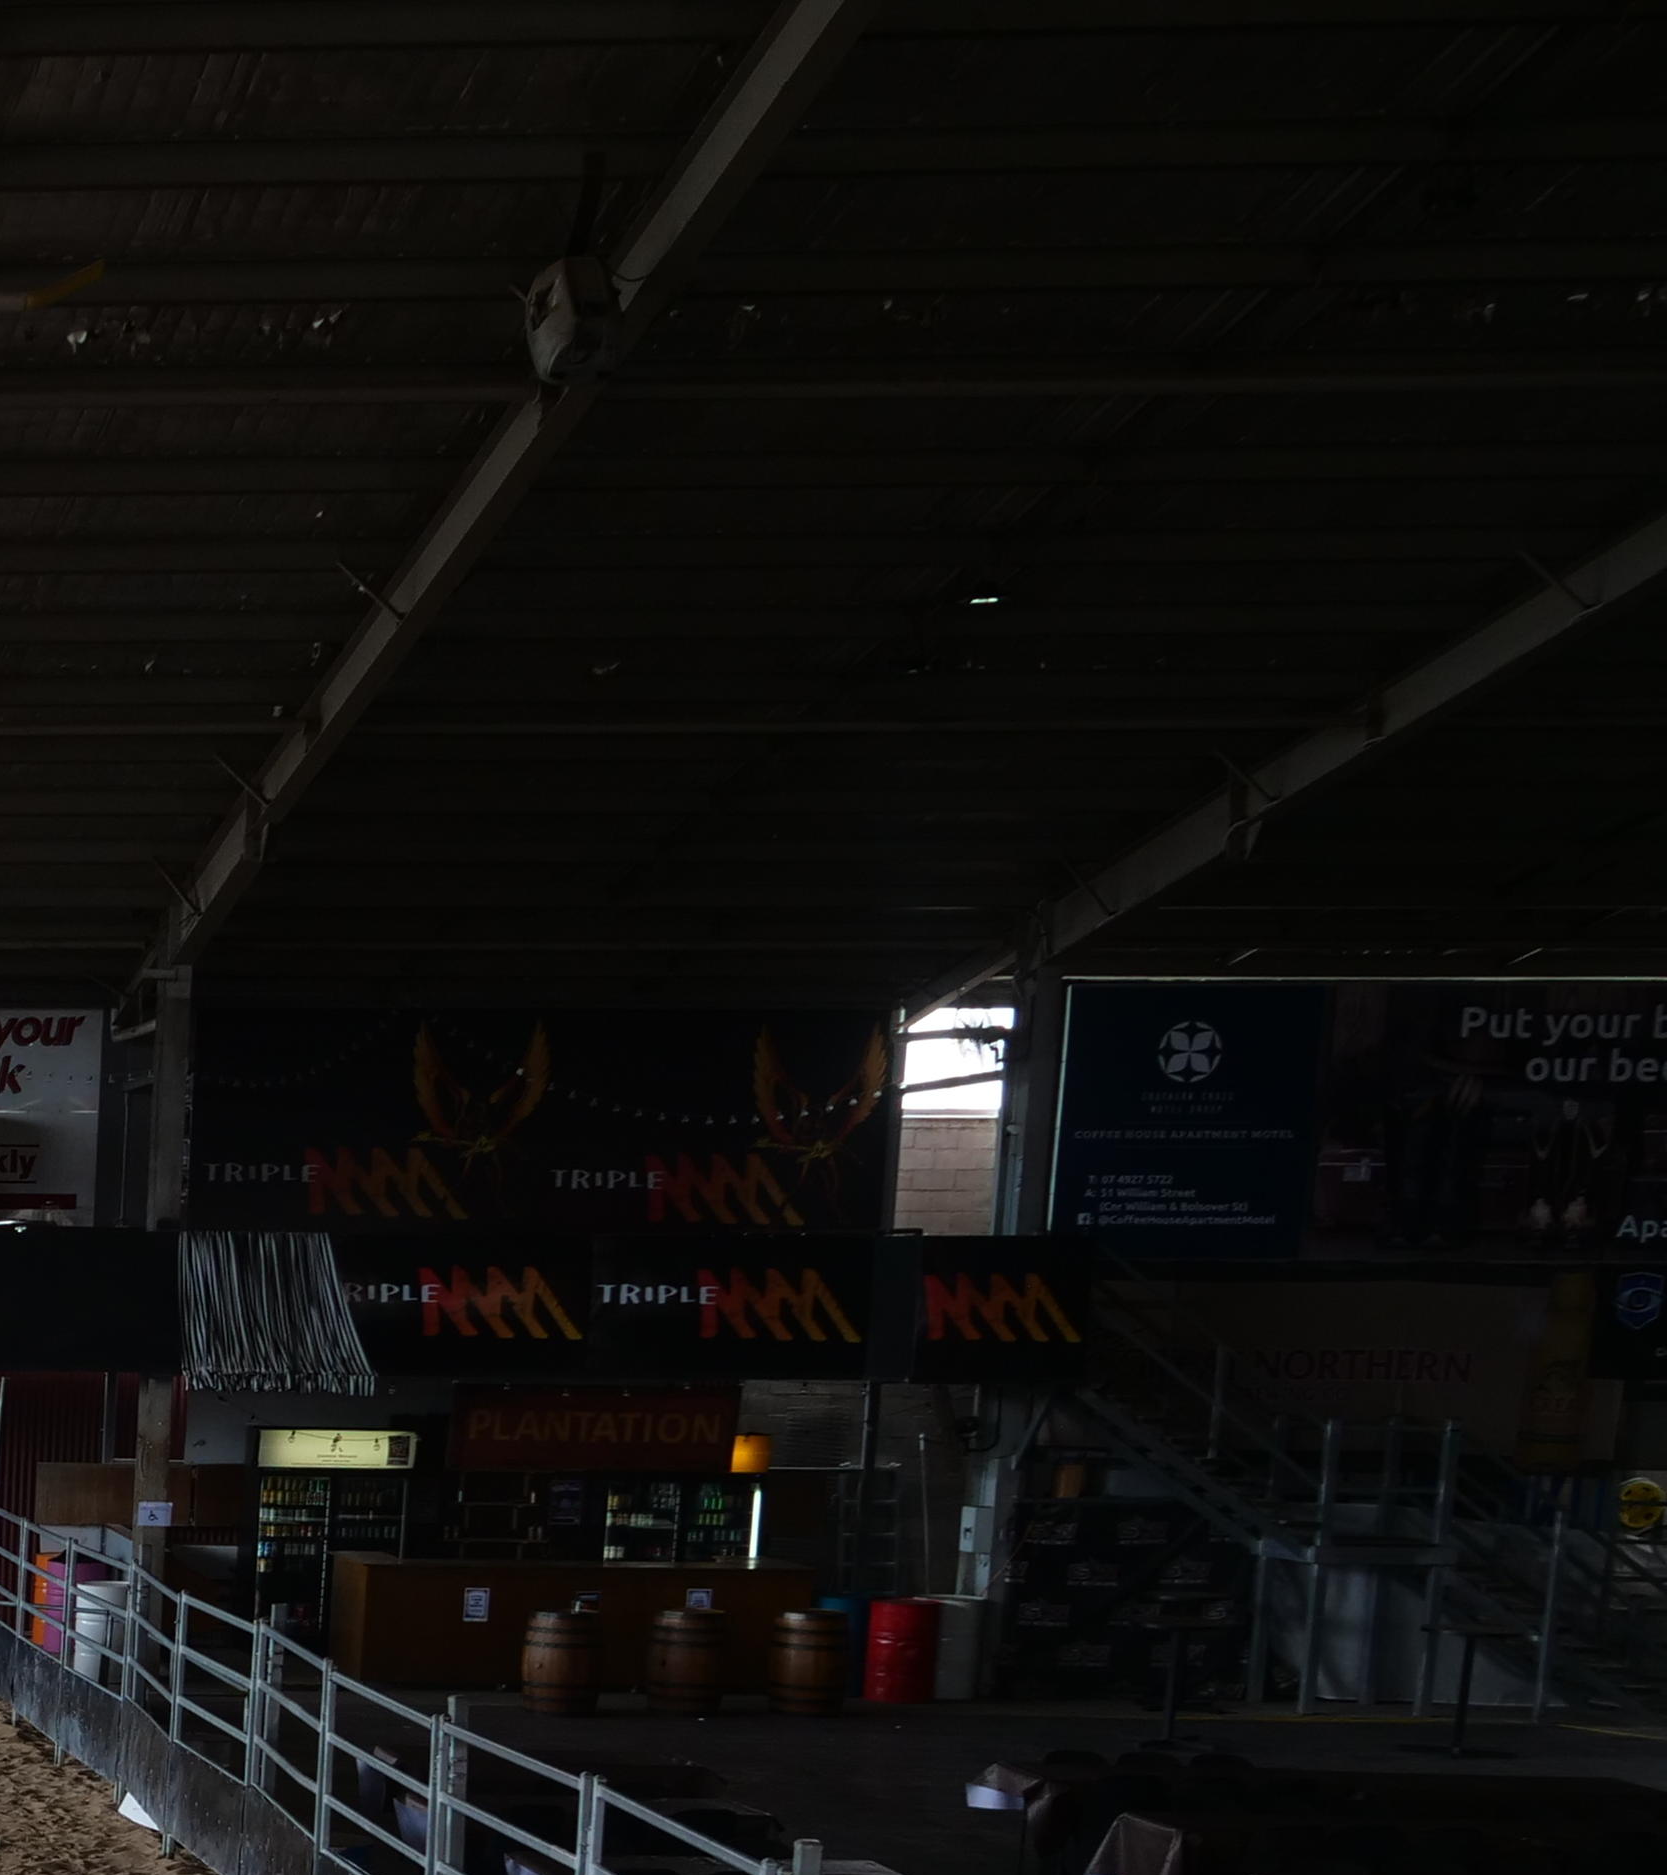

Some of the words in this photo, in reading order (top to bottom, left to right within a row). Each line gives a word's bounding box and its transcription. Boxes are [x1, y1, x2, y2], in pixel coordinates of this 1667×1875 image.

[1459, 1005, 1534, 1040] Put
[1542, 1013, 1642, 1047] your
[1524, 1055, 1598, 1083] our
[1608, 1047, 1667, 1083] be
[202, 1162, 324, 1183] TRIPLE
[548, 1170, 664, 1191] TRIPLE
[341, 1282, 444, 1304] RIPLE
[596, 1282, 722, 1305] TRIPLE
[1254, 1349, 1475, 1383] NORTHERN
[467, 1408, 721, 1444] PLANTATION
